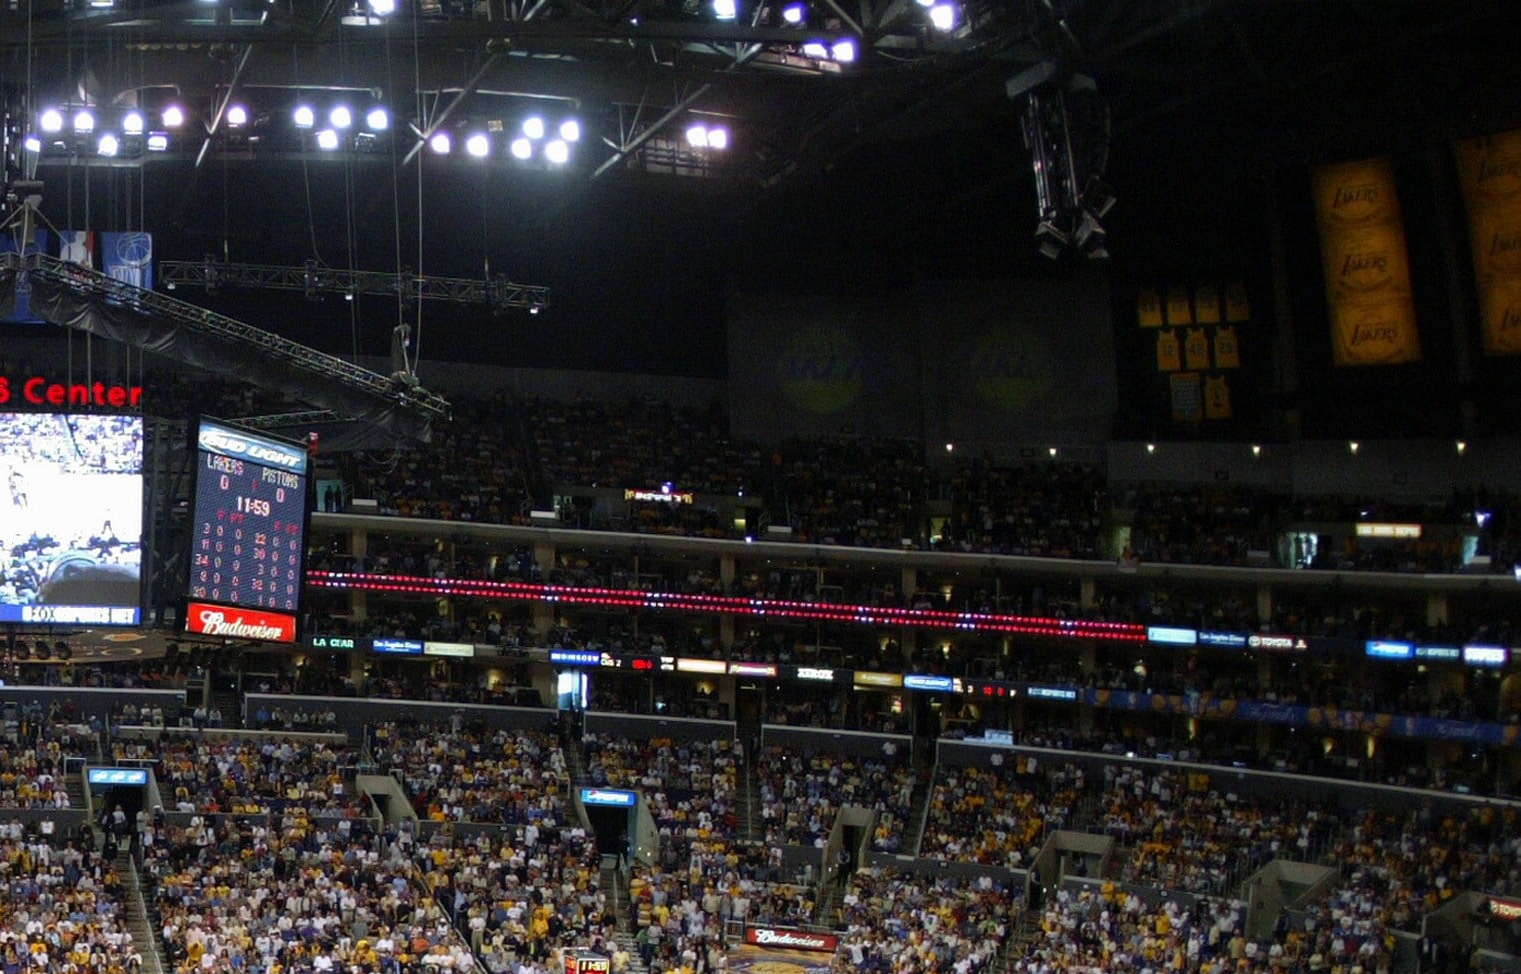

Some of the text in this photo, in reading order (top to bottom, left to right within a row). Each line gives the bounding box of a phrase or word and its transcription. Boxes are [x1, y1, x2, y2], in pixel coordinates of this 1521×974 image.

[24, 376, 142, 406] Center
[248, 445, 301, 467] LIGHT
[207, 453, 298, 489] LAKERS PISTONS
[220, 475, 229, 490] 0
[276, 488, 286, 503] 0
[237, 496, 271, 517] 11:59
[200, 610, 283, 640] Budweiser
[312, 638, 327, 647] LA
[797, 668, 833, 680] XEROX
[755, 929, 825, 948] Budweiser
